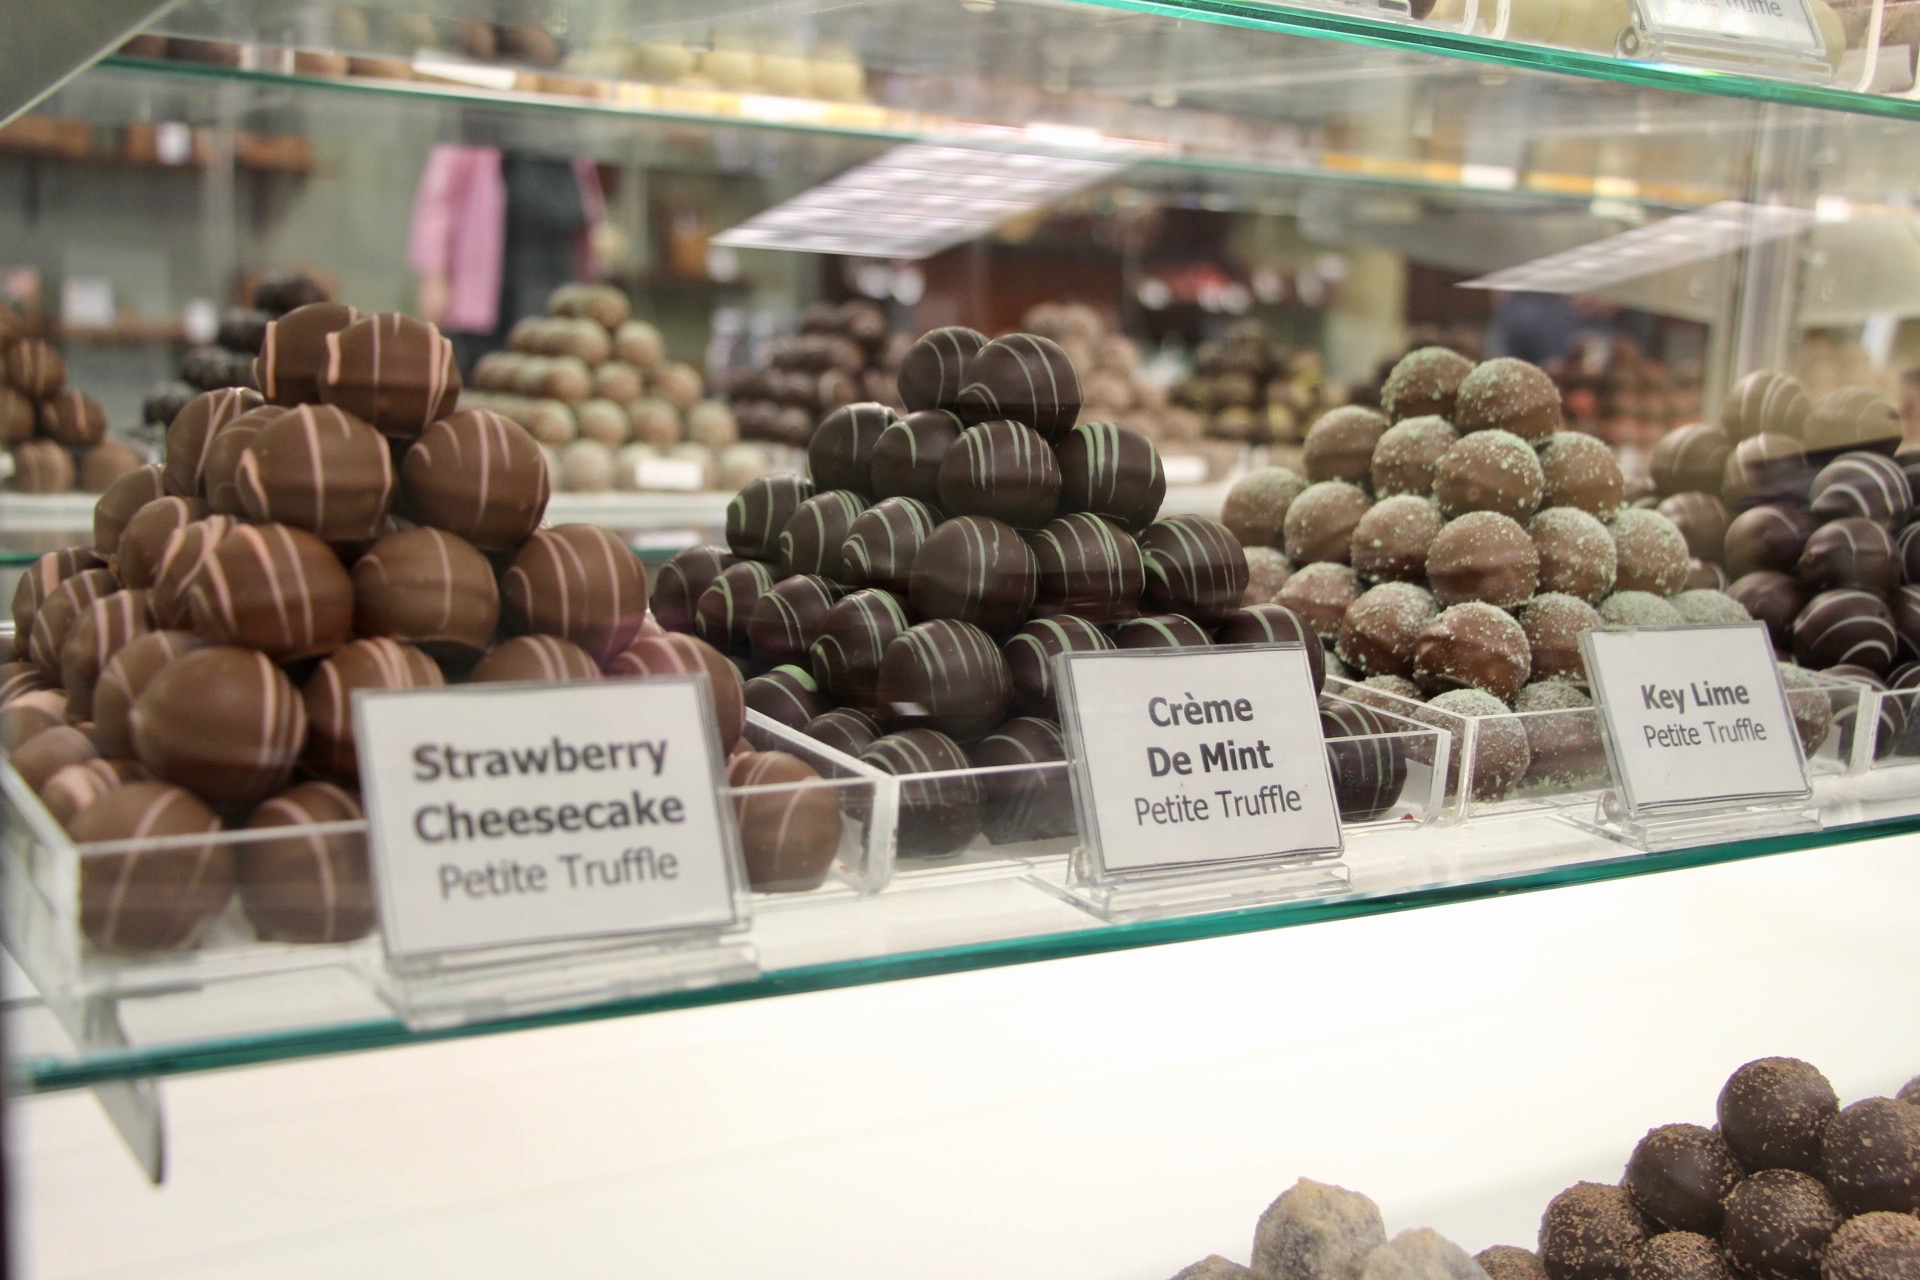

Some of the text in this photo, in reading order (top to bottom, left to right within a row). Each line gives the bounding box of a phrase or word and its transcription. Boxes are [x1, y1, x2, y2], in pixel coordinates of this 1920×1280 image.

[1148, 692, 1253, 727] Crème
[1641, 680, 1750, 714] Key Lime
[1643, 717, 1767, 748] Petite Truffle
[412, 735, 667, 781] Strawberry
[1147, 740, 1274, 777] De Mint
[414, 790, 685, 843] Cheesecake
[1134, 784, 1302, 826] Petite Truffle
[438, 847, 679, 899] Petite Truffle
